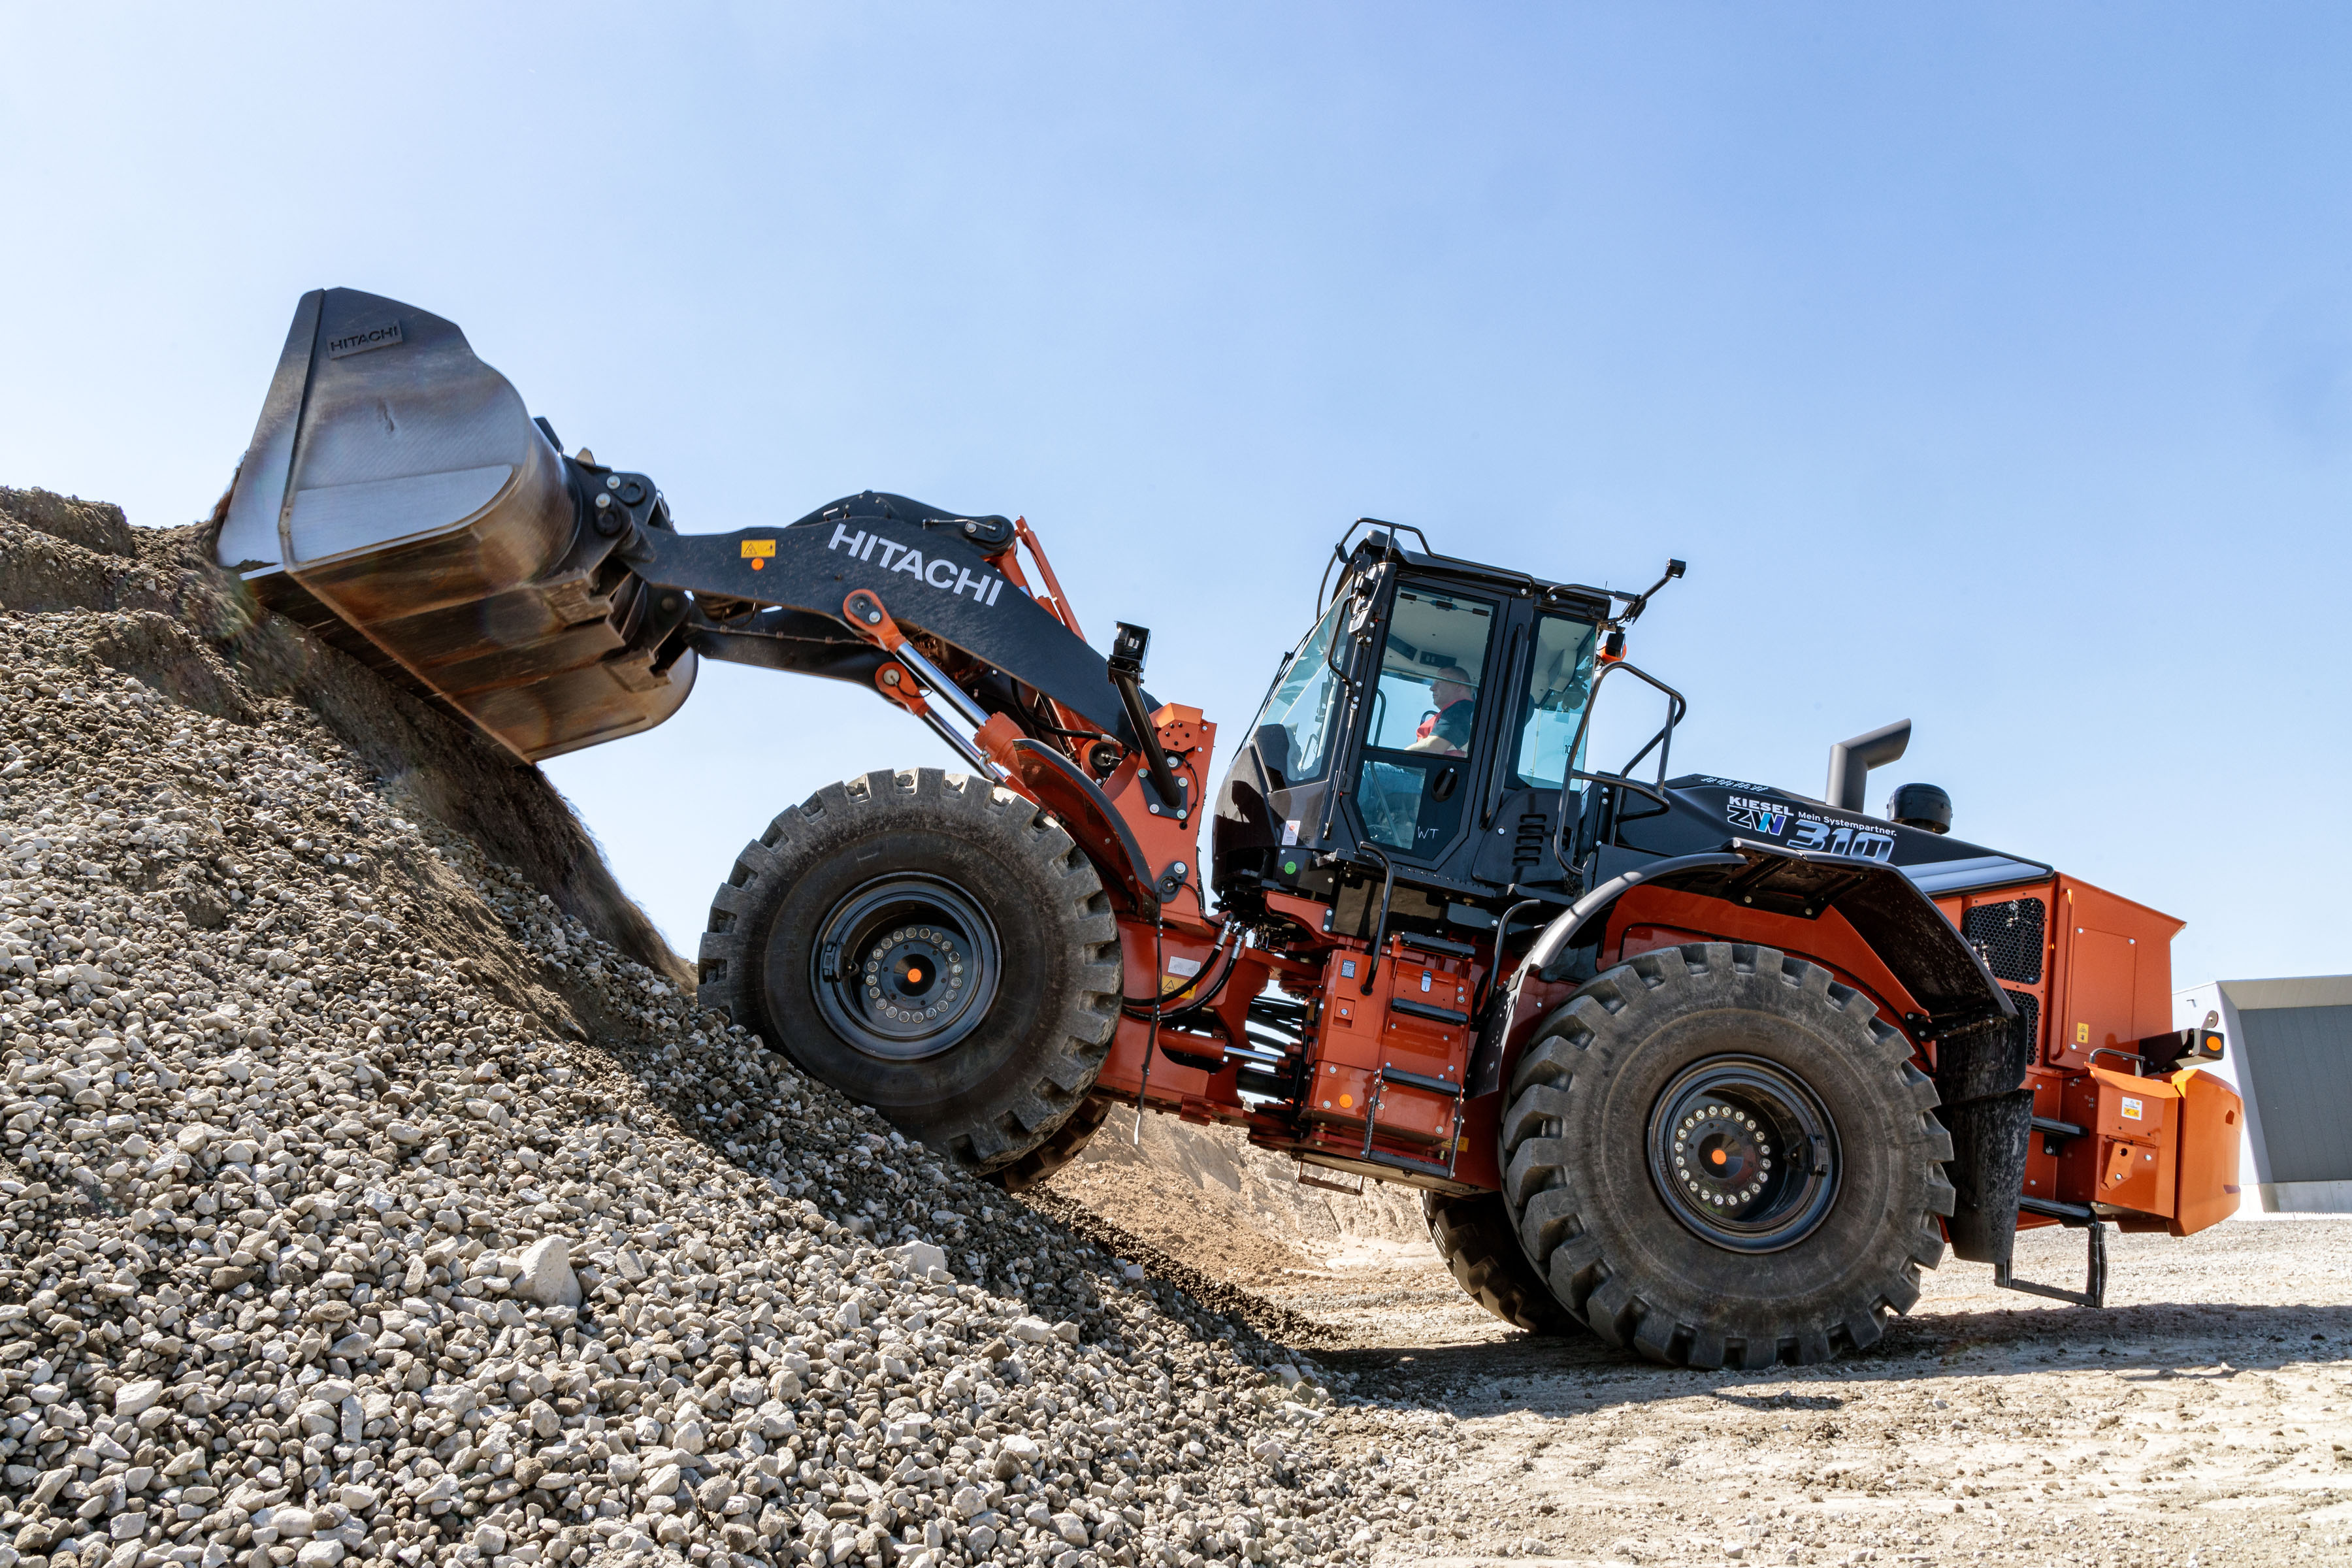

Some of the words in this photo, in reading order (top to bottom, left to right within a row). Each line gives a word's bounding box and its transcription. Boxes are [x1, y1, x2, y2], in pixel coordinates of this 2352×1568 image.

[330, 326, 398, 351] HITACHI
[828, 523, 1004, 607] HITACHI
[1418, 826, 1440, 840] WT
[1727, 804, 1788, 836] ZW
[1786, 819, 1895, 862] 310
[1729, 796, 1794, 817] KIESEL
[1798, 811, 1821, 822] Mein
[1823, 816, 1897, 836] Systempartner.
